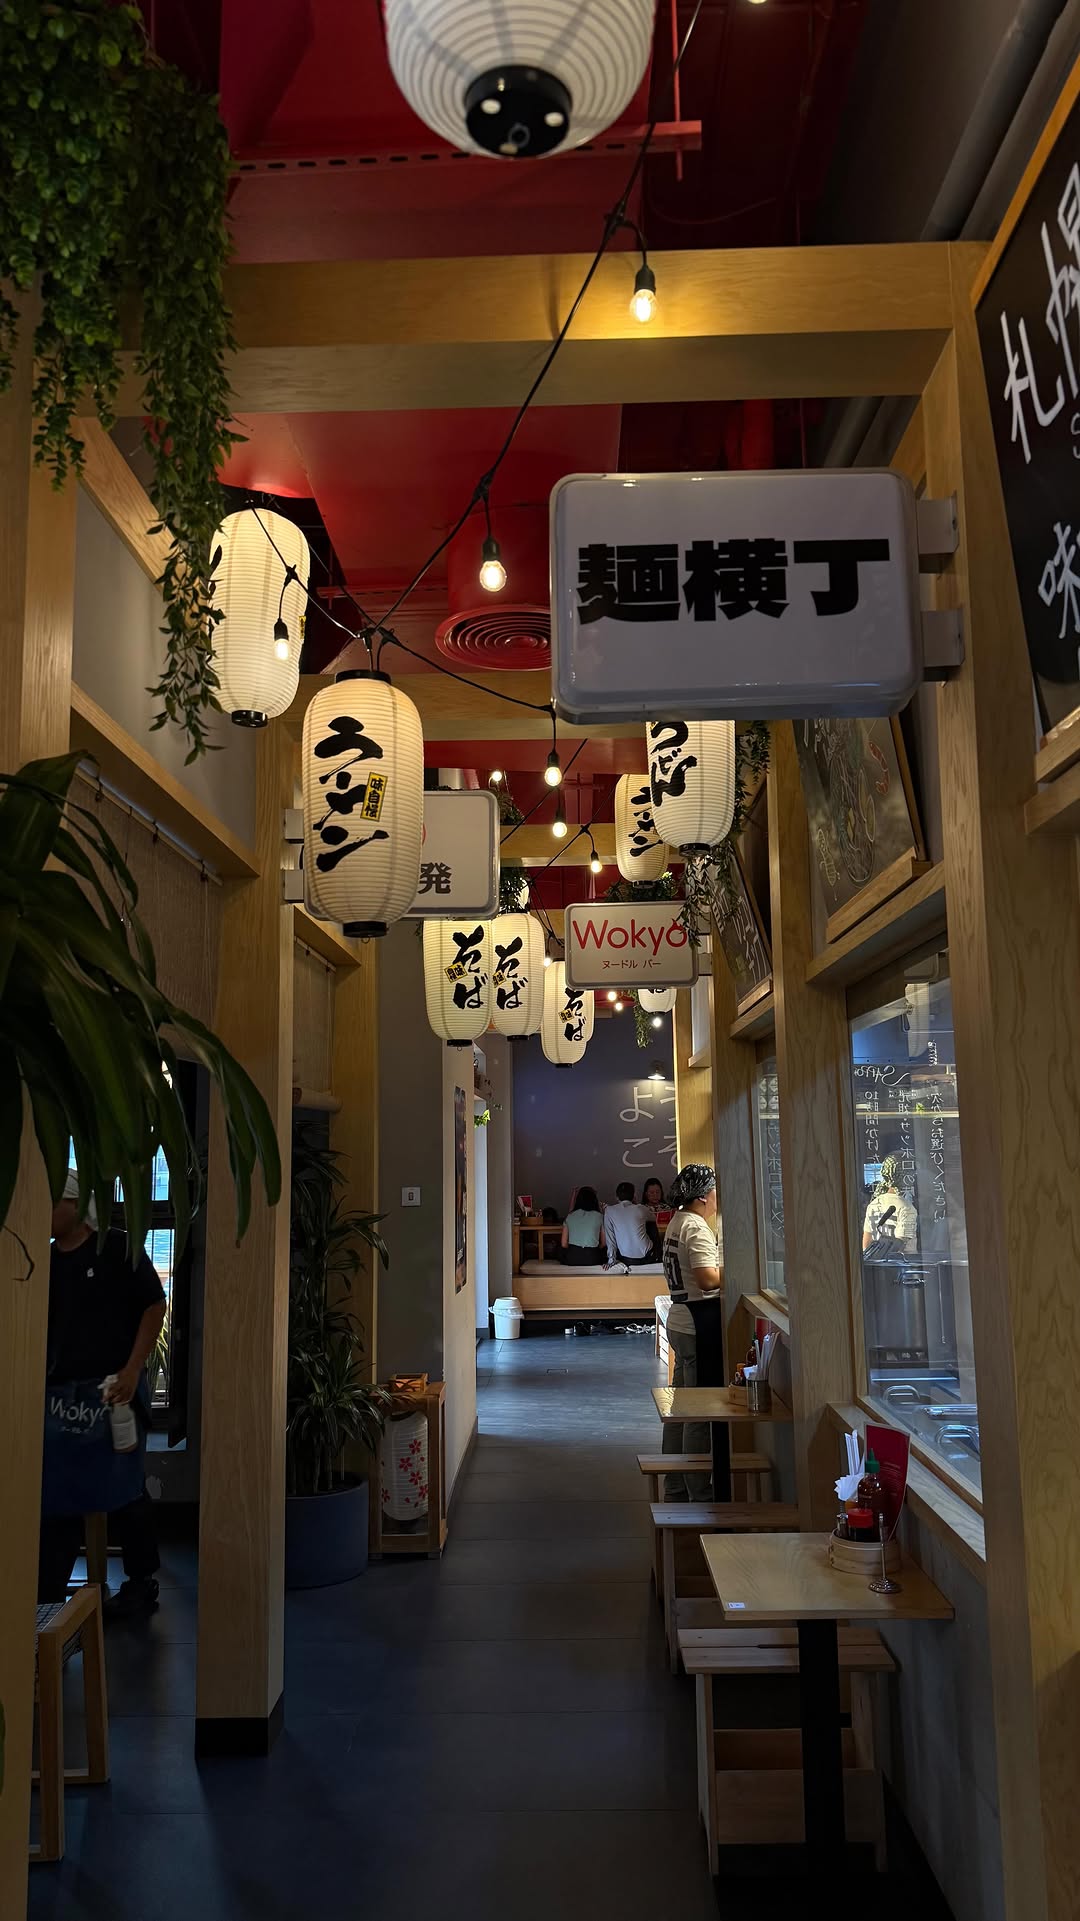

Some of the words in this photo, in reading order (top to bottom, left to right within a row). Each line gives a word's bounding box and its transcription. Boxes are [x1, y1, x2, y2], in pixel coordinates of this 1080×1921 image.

[576, 538, 890, 625] 麺横丁
[1037, 521, 1080, 640] 味
[417, 862, 452, 894] 発
[602, 959, 638, 970] ヌードル
[642, 959, 662, 969] バー
